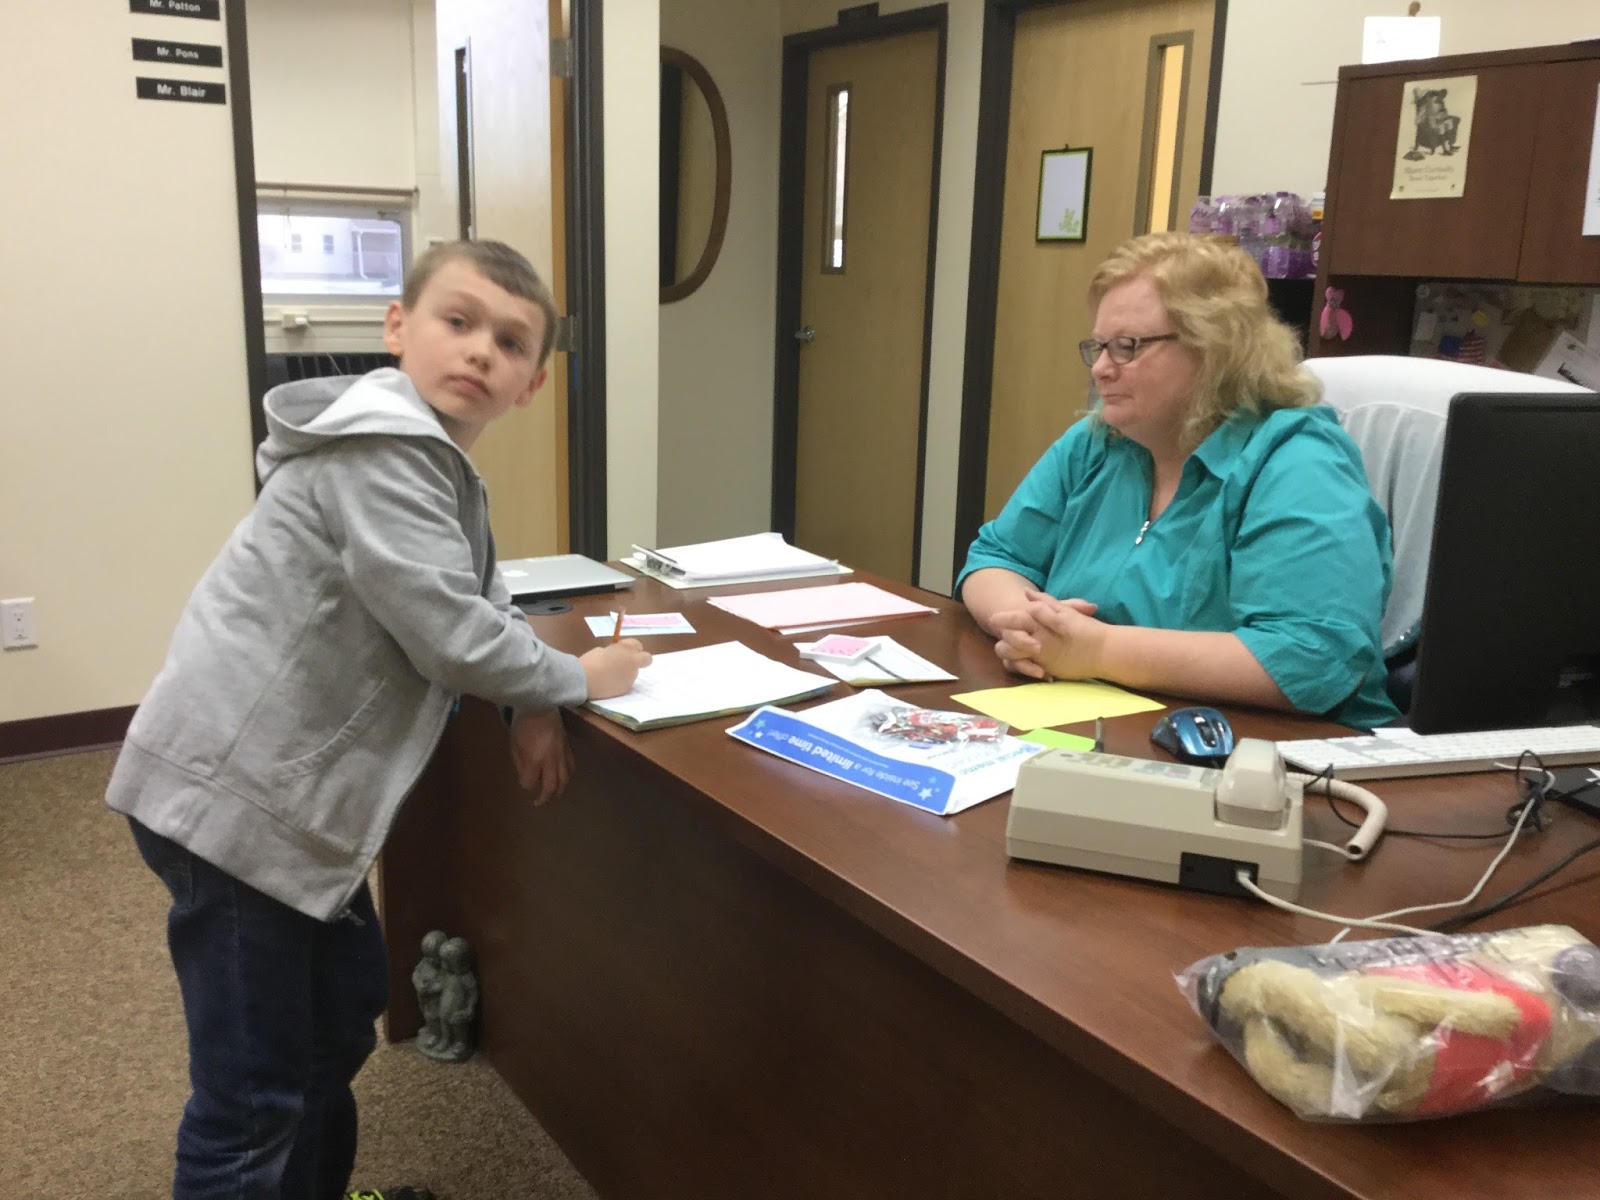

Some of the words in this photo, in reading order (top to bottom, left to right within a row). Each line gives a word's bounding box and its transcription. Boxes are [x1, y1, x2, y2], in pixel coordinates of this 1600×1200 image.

[149, 0, 165, 8] Mr.
[168, 0, 201, 12] Patton
[157, 83, 175, 96] Mr.
[180, 85, 206, 98] Blair
[787, 736, 814, 753] time
[811, 745, 854, 771] limited
[861, 765, 876, 777] for
[876, 770, 903, 785] inside
